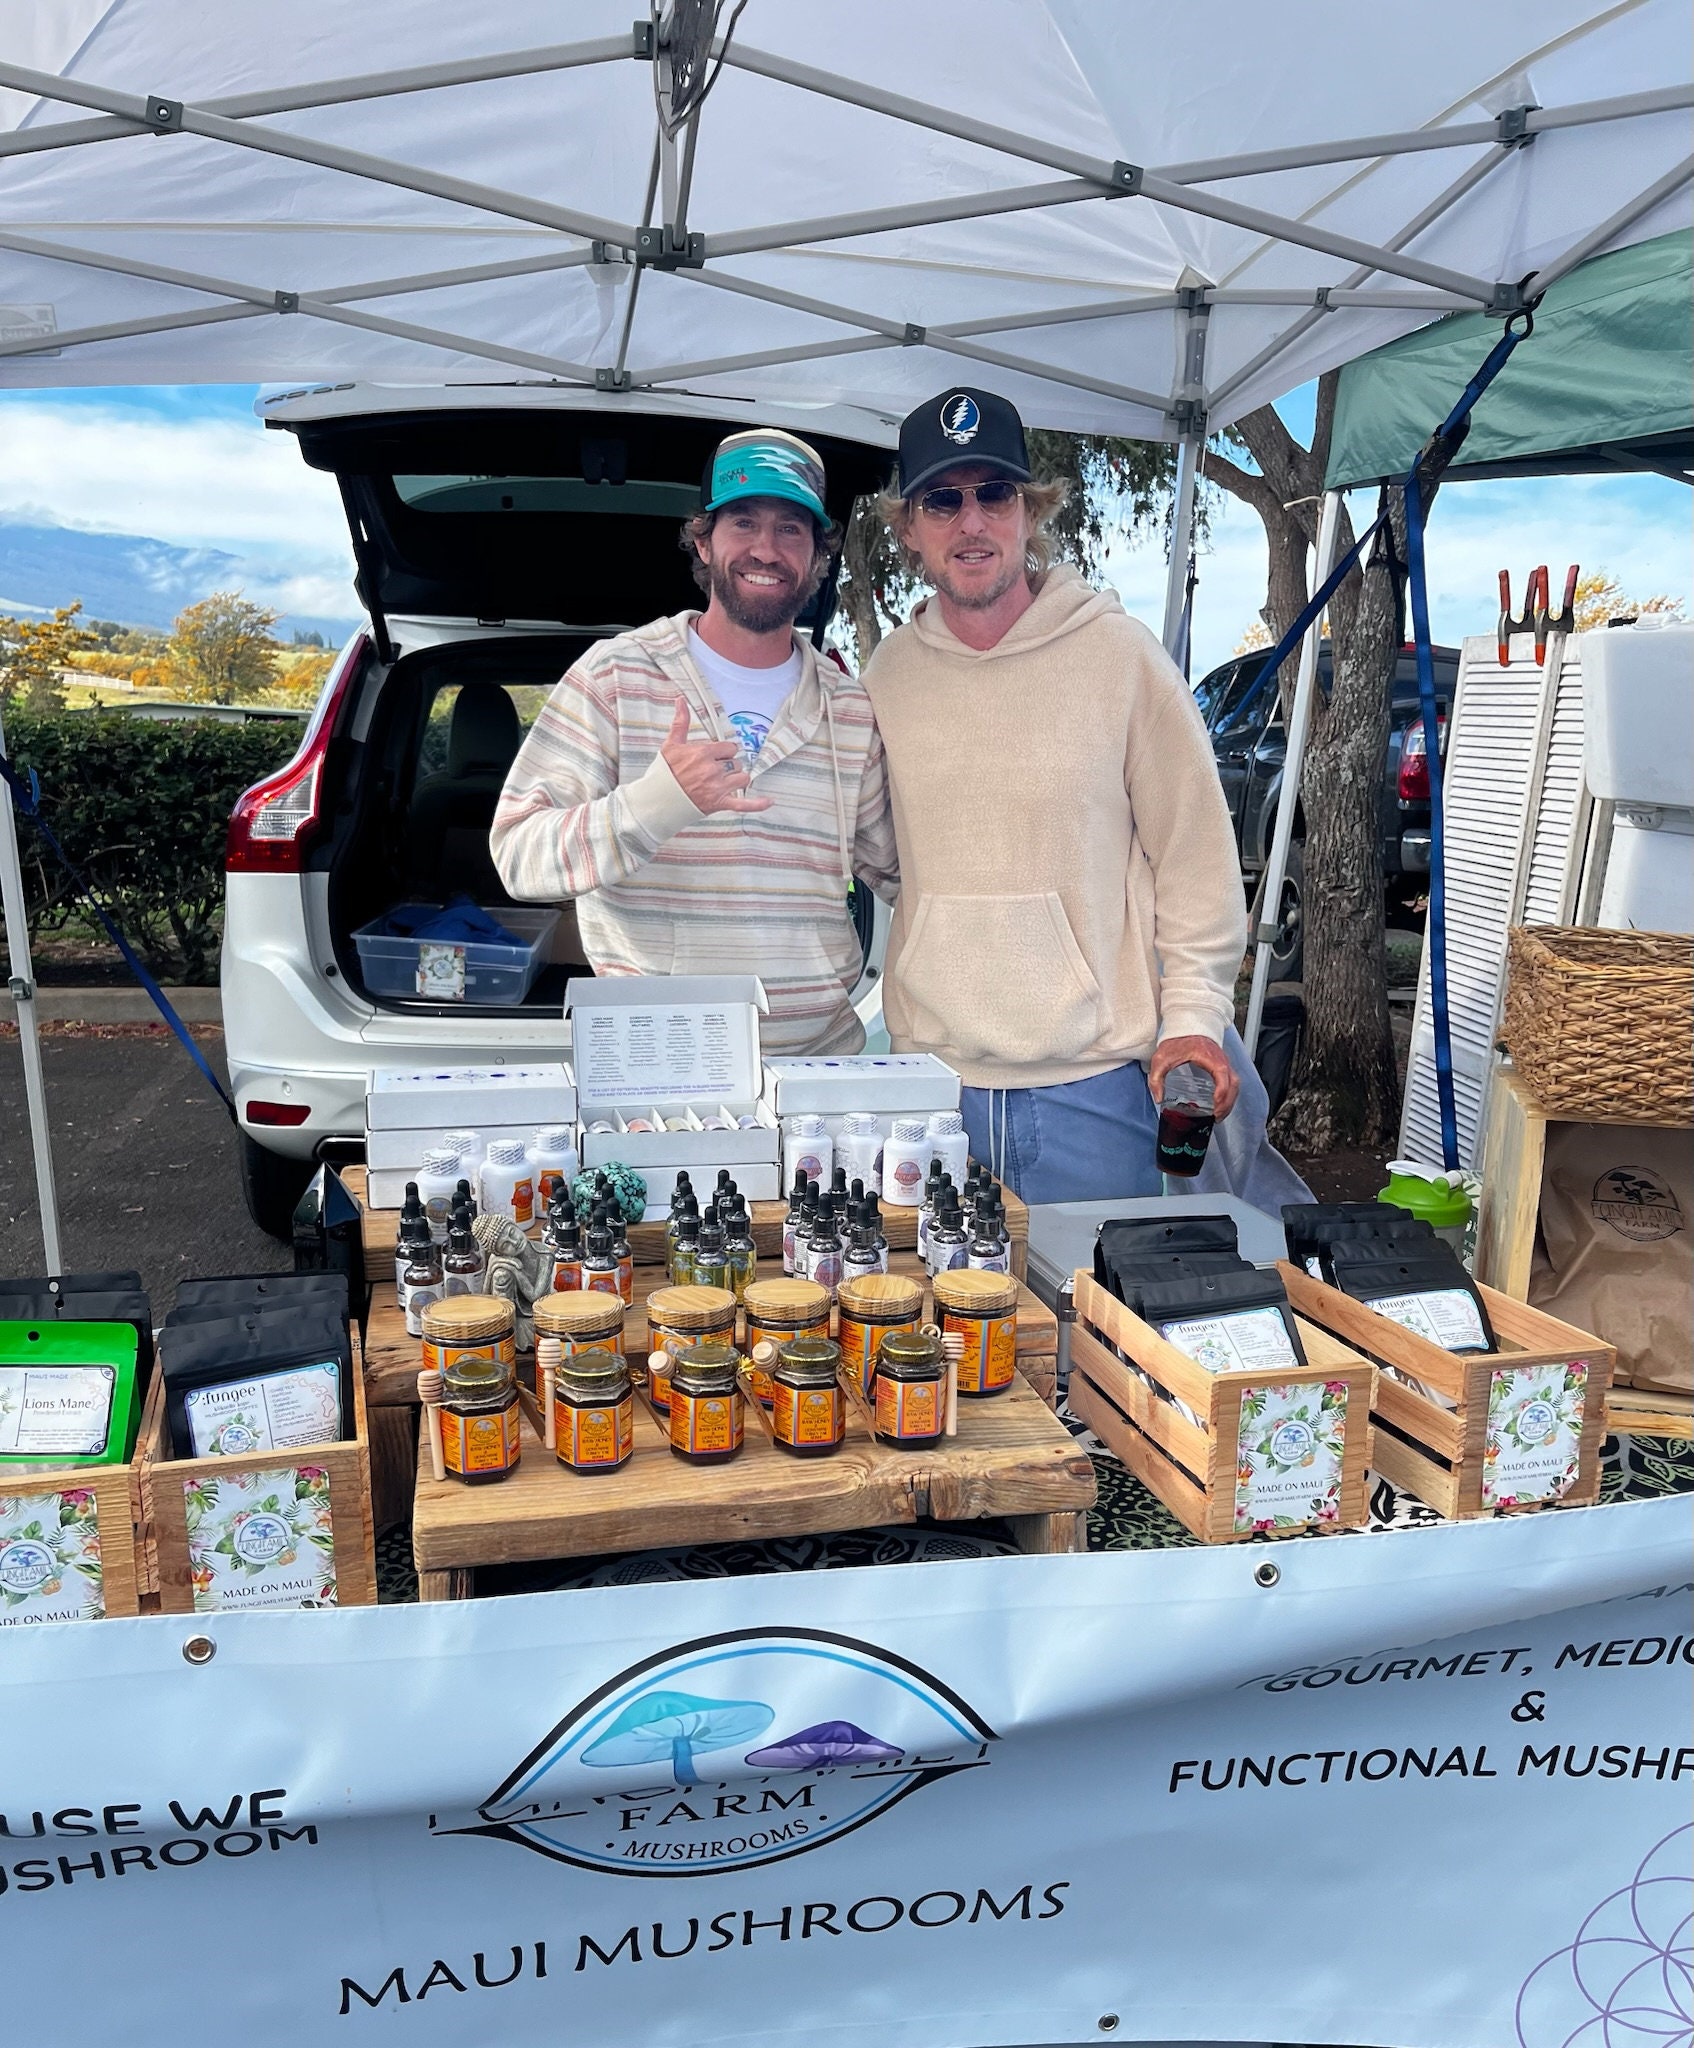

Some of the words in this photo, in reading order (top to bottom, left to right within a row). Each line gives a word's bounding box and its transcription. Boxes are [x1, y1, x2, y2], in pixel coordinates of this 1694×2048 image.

[1626, 1220, 1660, 1228] FARM
[24, 1398, 55, 1408] Lions
[58, 1398, 92, 1408] Mane
[1503, 1462, 1526, 1472] MADE
[1528, 1461, 1540, 1469] ON
[1541, 1458, 1563, 1466] MAUI
[1257, 1484, 1283, 1493] MADE
[223, 1588, 257, 1599] MADE
[261, 1584, 279, 1594] ON
[282, 1579, 312, 1590] MAUI
[24, 1615, 42, 1624] ON
[47, 1610, 79, 1621] MAUI
[1263, 1647, 1533, 1693] GOURMET,
[1510, 1690, 1546, 1723] &
[1168, 1745, 1497, 1794] FUNCTIONAL
[168, 1789, 287, 1832] WE
[616, 1783, 818, 1832] FARM
[622, 1818, 809, 1861] MUSHROOMS
[338, 1942, 547, 2015] MAUI
[574, 1882, 1070, 1972] MUSHROOMS
